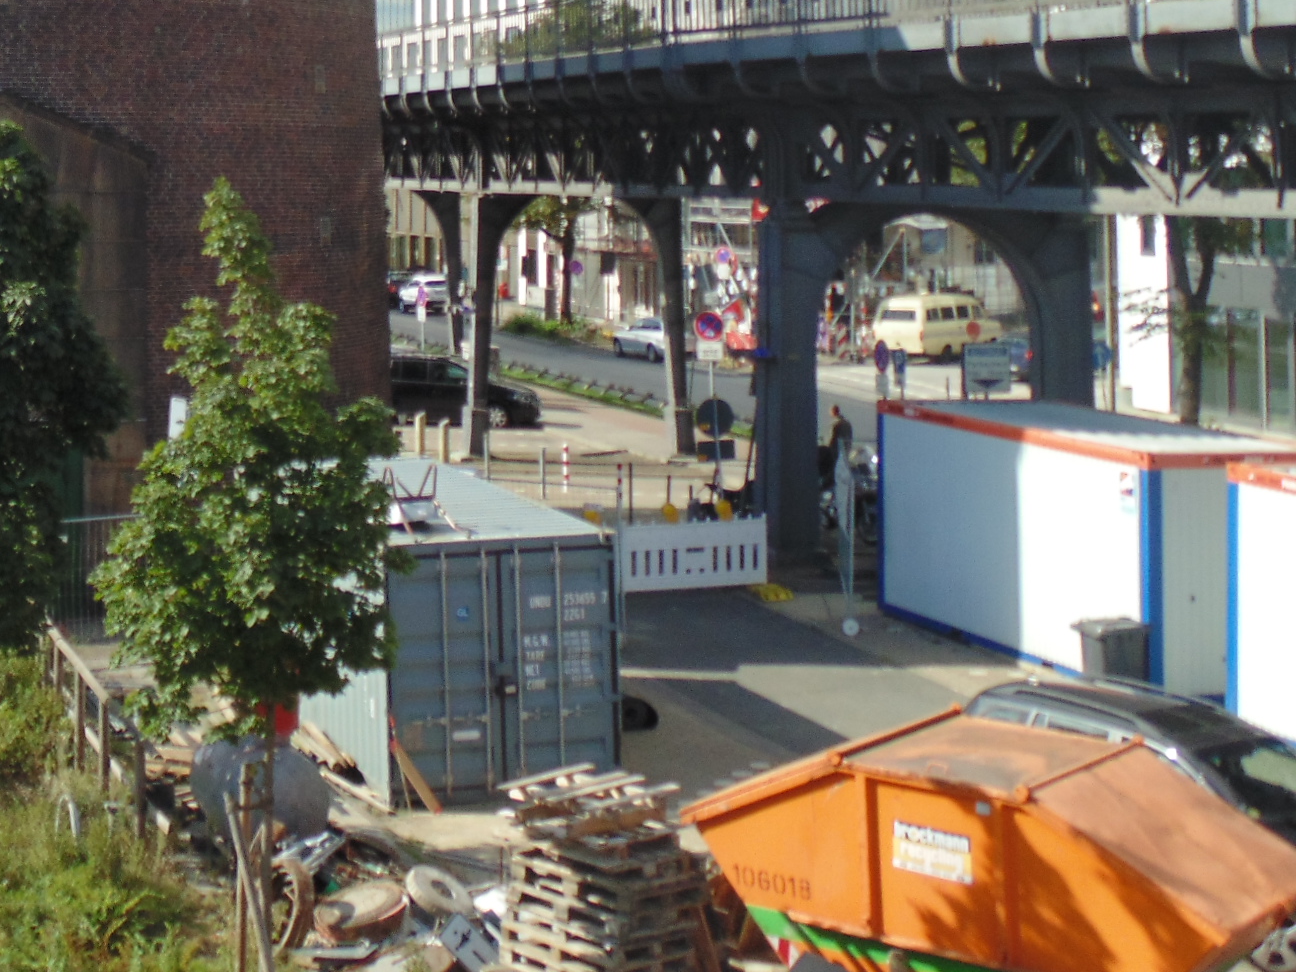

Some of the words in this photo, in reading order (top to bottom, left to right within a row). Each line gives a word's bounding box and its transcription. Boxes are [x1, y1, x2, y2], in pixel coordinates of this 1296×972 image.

[893, 819, 970, 853] brockmann
[899, 840, 965, 877] recycling
[732, 862, 812, 901] 106018
